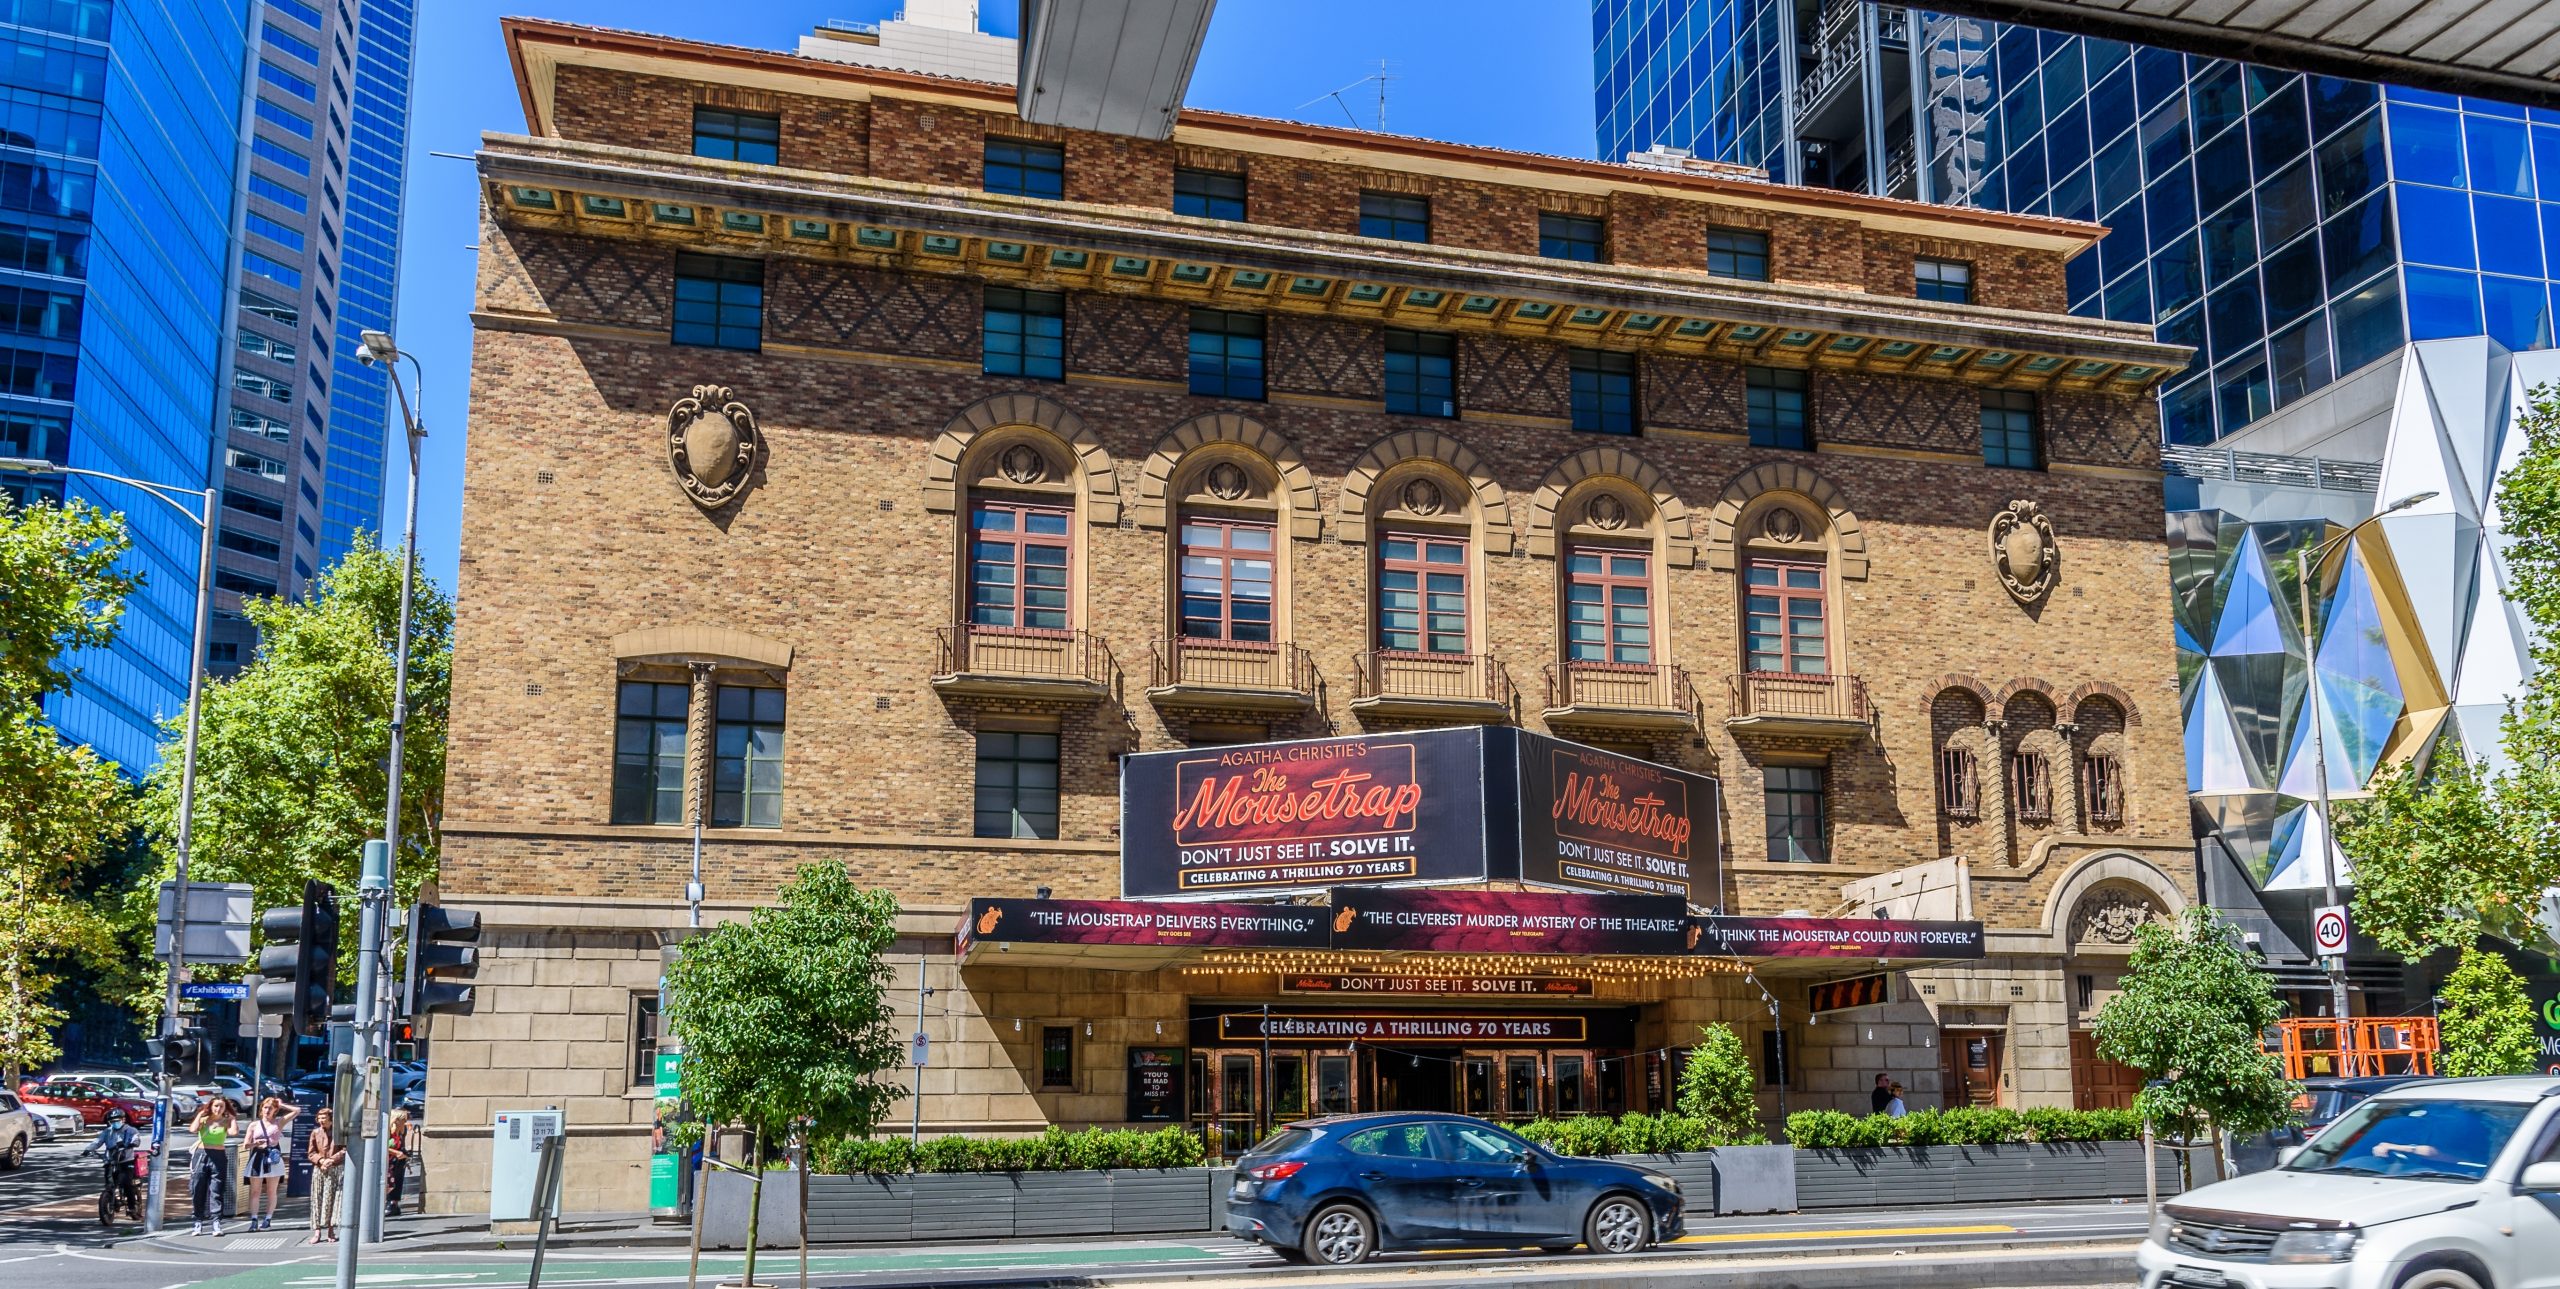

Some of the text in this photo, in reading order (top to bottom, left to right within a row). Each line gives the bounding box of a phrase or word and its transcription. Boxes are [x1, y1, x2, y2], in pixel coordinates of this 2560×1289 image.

[1220, 742, 1367, 767] AGATHA CHRISTIE'S
[1251, 767, 1287, 793] The
[1579, 752, 1662, 783] AGATHA CHRISTIE'S
[1599, 773, 1620, 799] The
[1173, 768, 1422, 831] Mousetrap
[1552, 772, 1691, 854] Mousetrap
[1181, 836, 1416, 865] DON'T JUST SEE IT. SOLVE IT.
[1558, 841, 1690, 878] DON'T JUST SEE IT. SOLVE IT.
[1190, 861, 1405, 884] CELEBRATING A THRILLING 70 YEARS
[1565, 865, 1686, 895] CELEBRATING A THRILLING 70 YEARS
[1030, 911, 1314, 932] "THE MOUSETRAP DELIVERS EVERYTHING."
[1363, 911, 1684, 932] "THE CLEVEREST MURDER MYSTERY OF THE THEATRE."
[2320, 921, 2341, 938] 40
[1721, 929, 1756, 941] THINK
[1758, 929, 1780, 941] THE
[1782, 929, 1850, 942] MOUSETRAP
[1852, 930, 1891, 943] COULD
[1894, 931, 1918, 944] RUN
[1921, 932, 1977, 945] FOREVER."
[192, 985, 247, 994] Exhibition St
[1341, 977, 1385, 990] DON'T
[1389, 978, 1420, 990] JUST
[1425, 979, 1447, 991] SEE
[1452, 979, 1466, 991] IT.
[1472, 979, 1516, 992] SOLVE
[1521, 980, 1537, 992] IT.
[1259, 1021, 1551, 1035] CELEBRATING A THRILLING 70 YEARS
